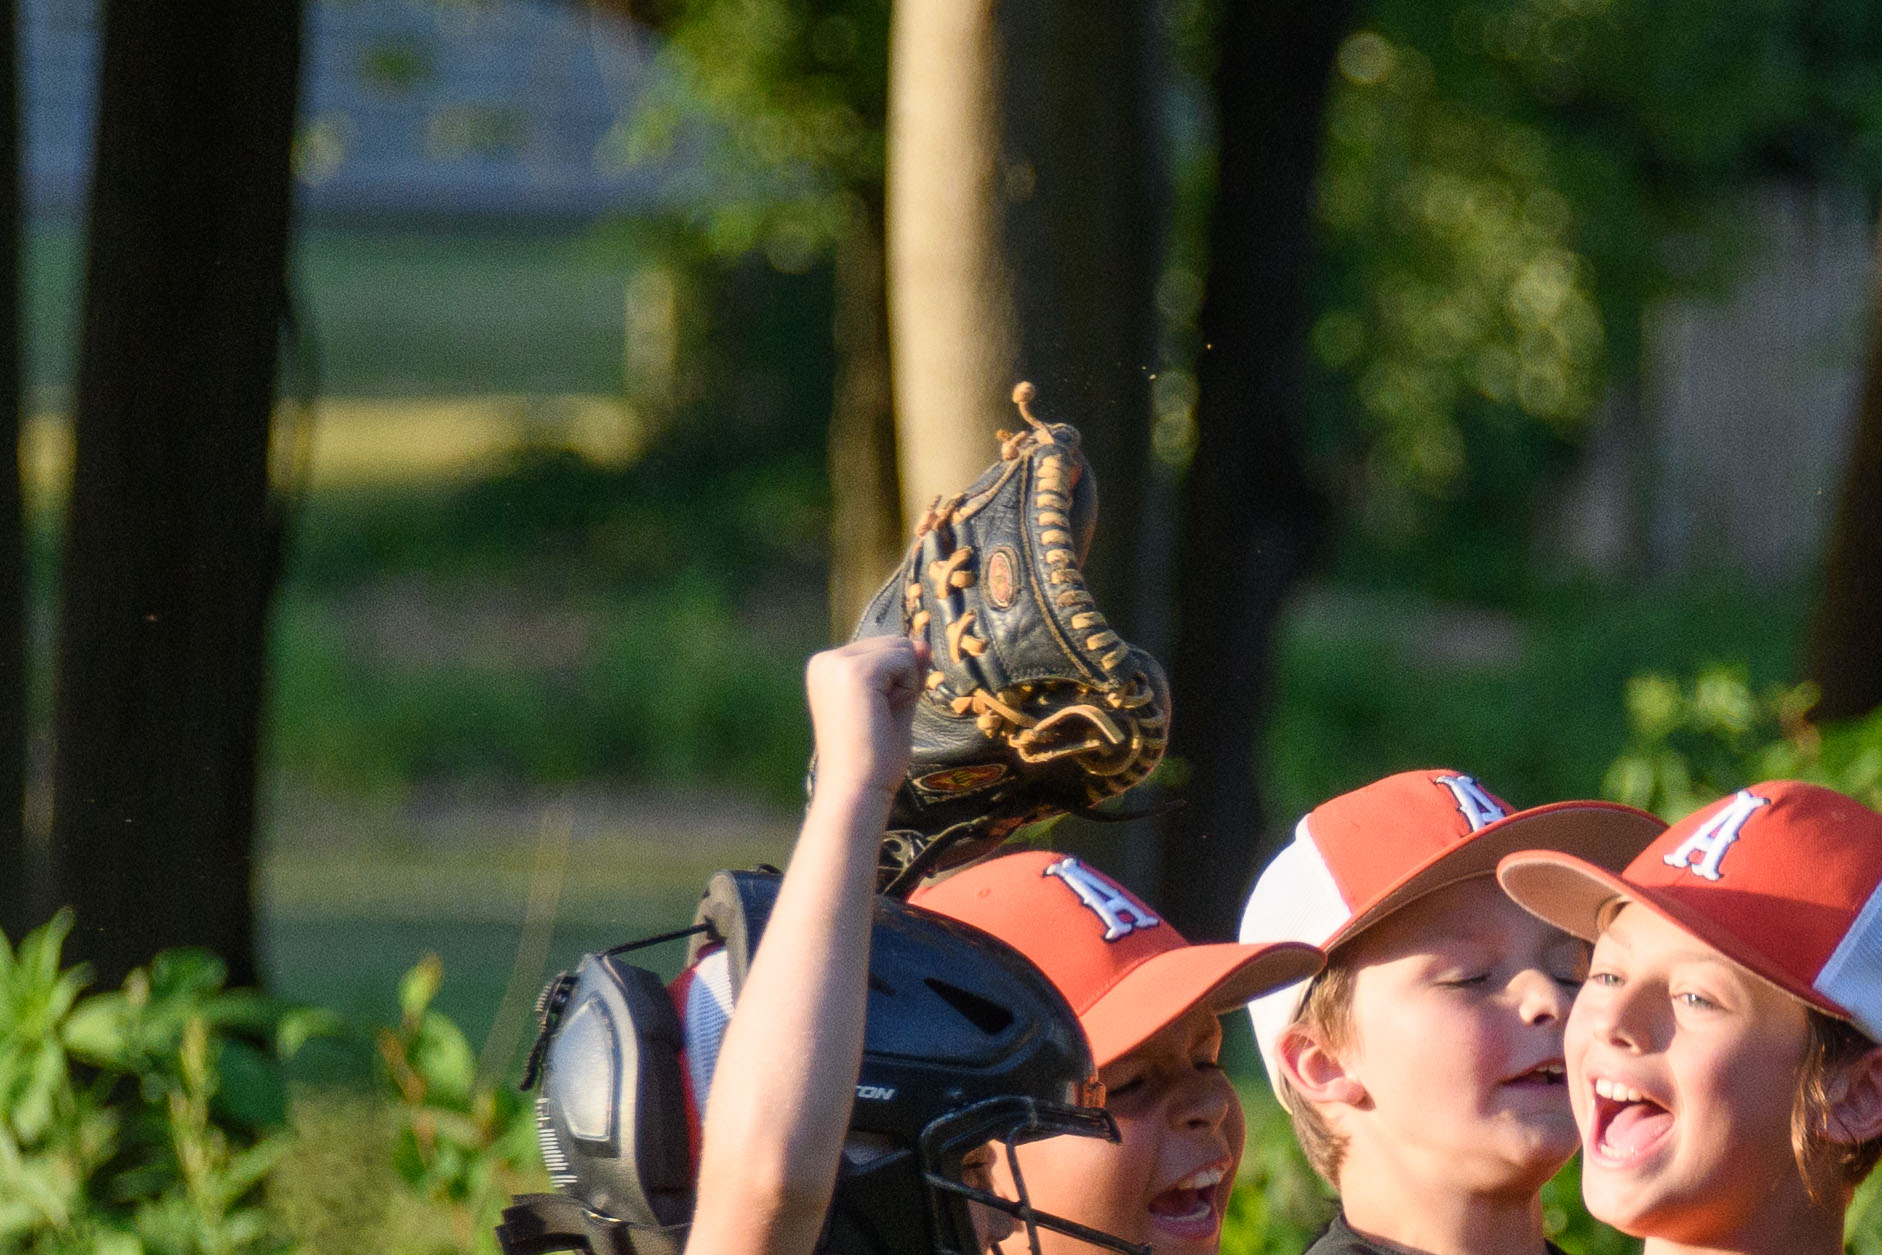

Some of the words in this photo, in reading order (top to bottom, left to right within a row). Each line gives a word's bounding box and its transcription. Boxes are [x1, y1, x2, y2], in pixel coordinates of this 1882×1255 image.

[1433, 774, 1506, 834] A
[1662, 789, 1771, 882] A
[1043, 857, 1161, 942] A
